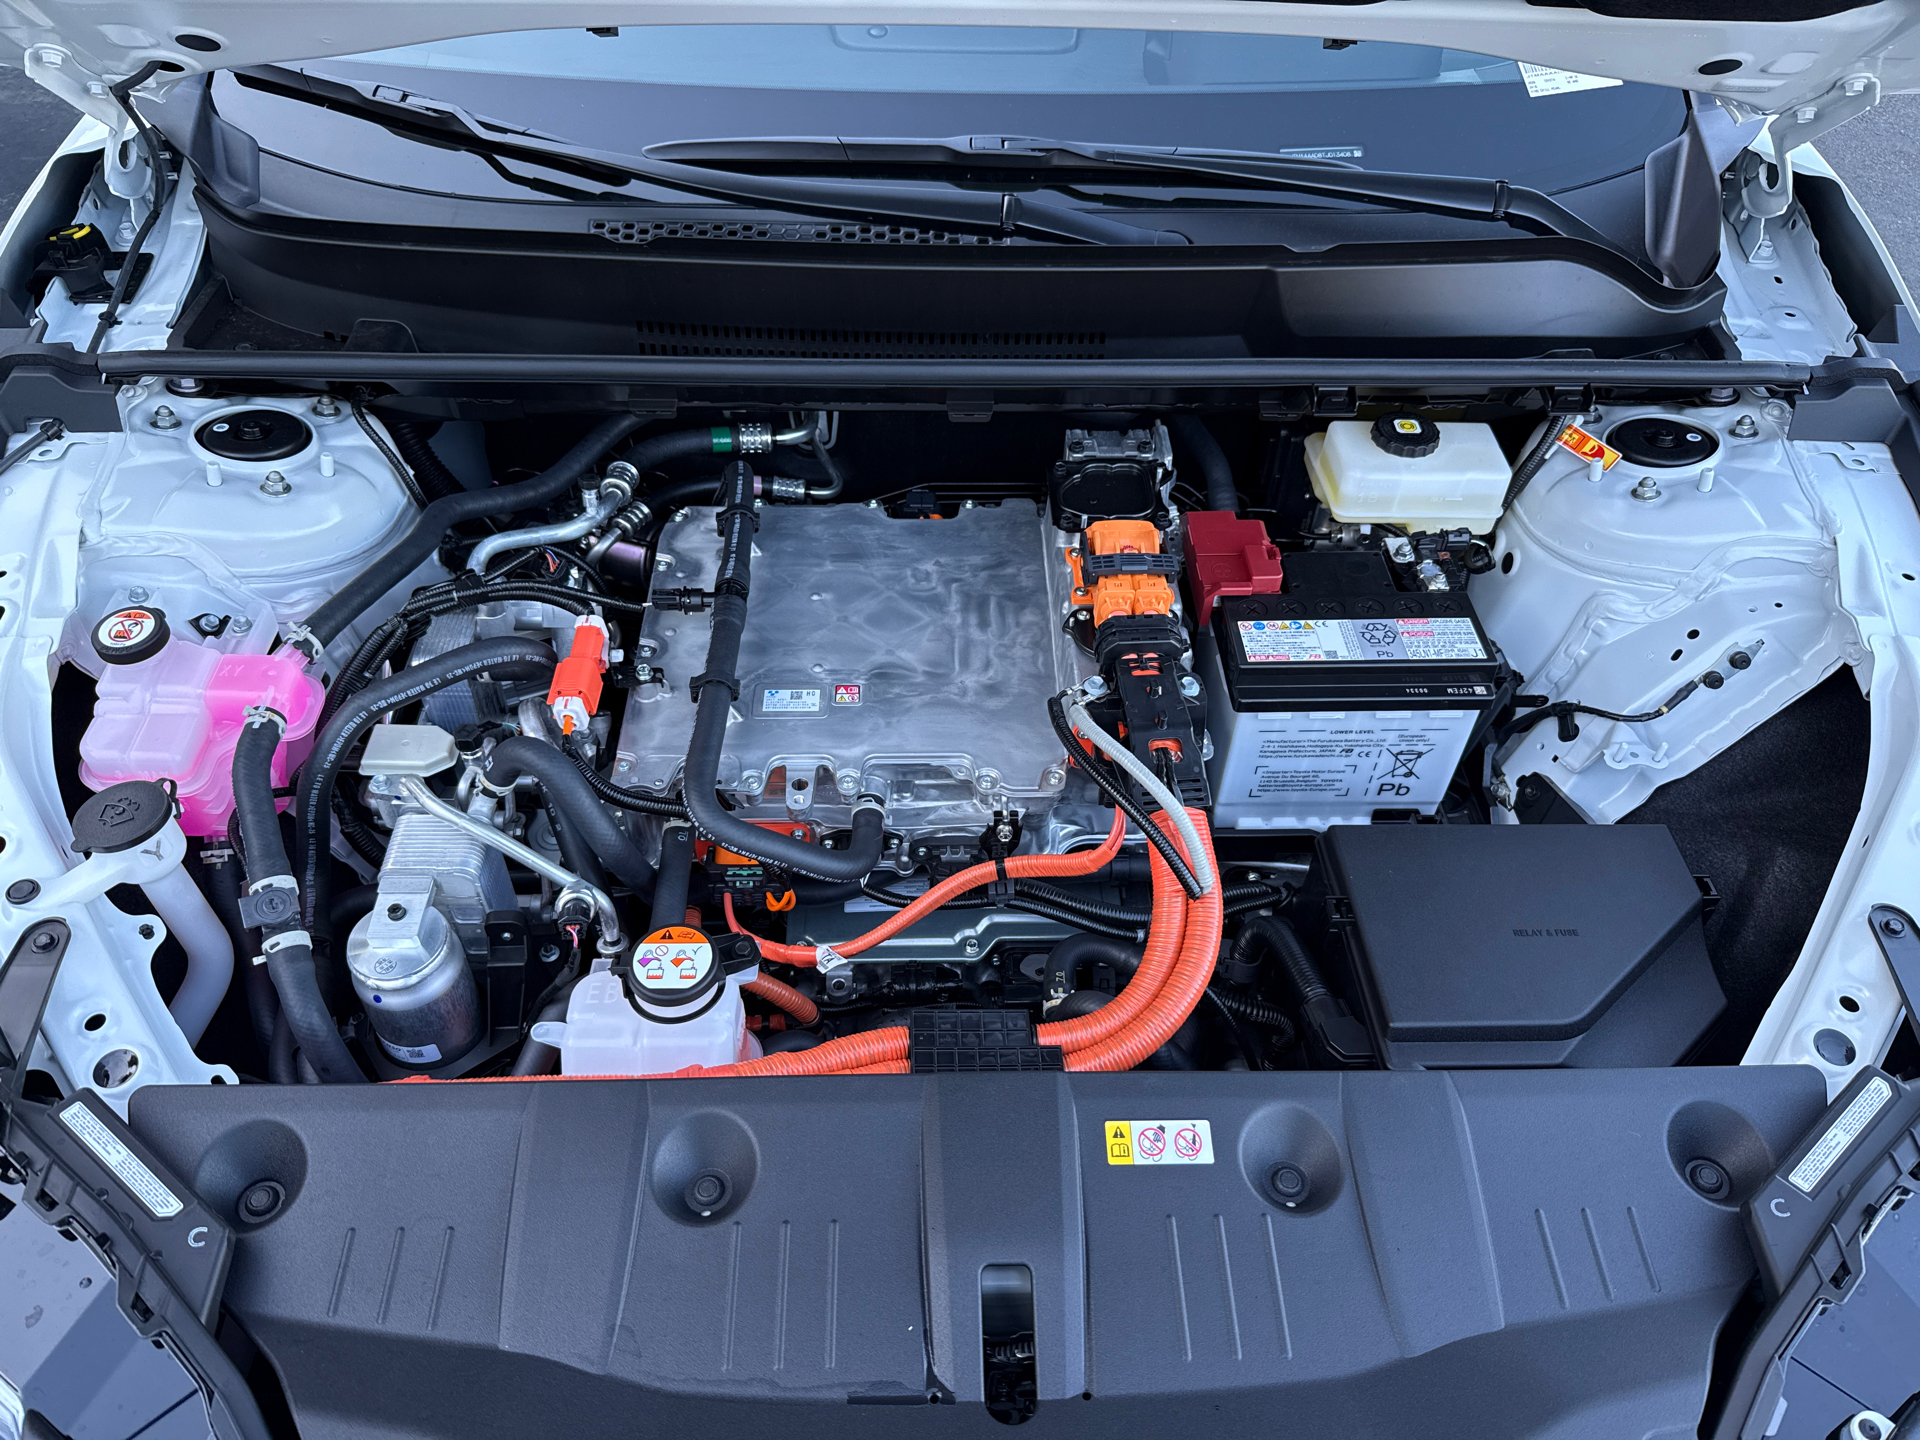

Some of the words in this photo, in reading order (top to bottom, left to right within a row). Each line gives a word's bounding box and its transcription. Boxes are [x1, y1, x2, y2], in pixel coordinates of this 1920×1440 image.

[219, 664, 243, 677] XY
[1377, 783, 1410, 796] Pb
[586, 982, 620, 1004] EB
[1770, 1198, 1791, 1217] C
[188, 1226, 208, 1247] C
